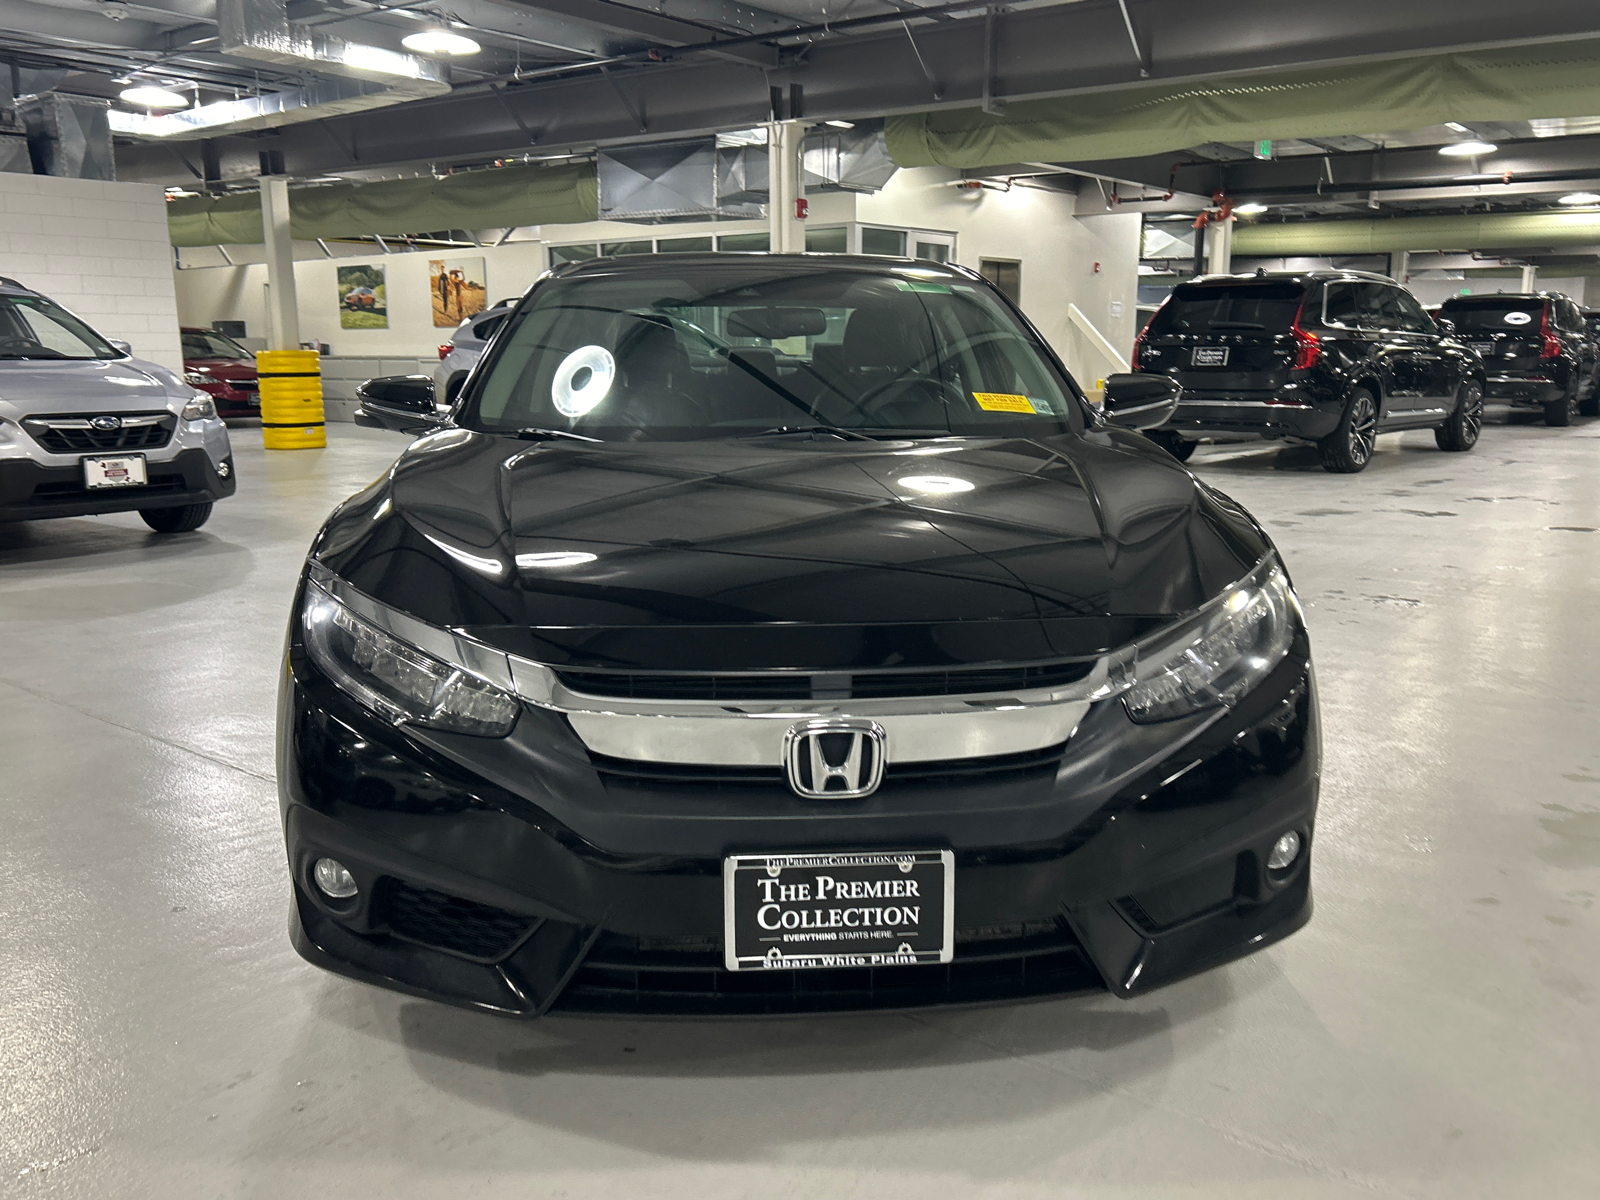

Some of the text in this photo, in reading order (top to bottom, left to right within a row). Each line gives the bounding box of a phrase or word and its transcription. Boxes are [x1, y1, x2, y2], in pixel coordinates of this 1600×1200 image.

[757, 876, 921, 903] THE PREMIER
[756, 903, 921, 931] COLLECTION
[783, 930, 895, 943] EVERYTHING STARTS HERE.
[762, 953, 918, 969] Subaru White Plains
